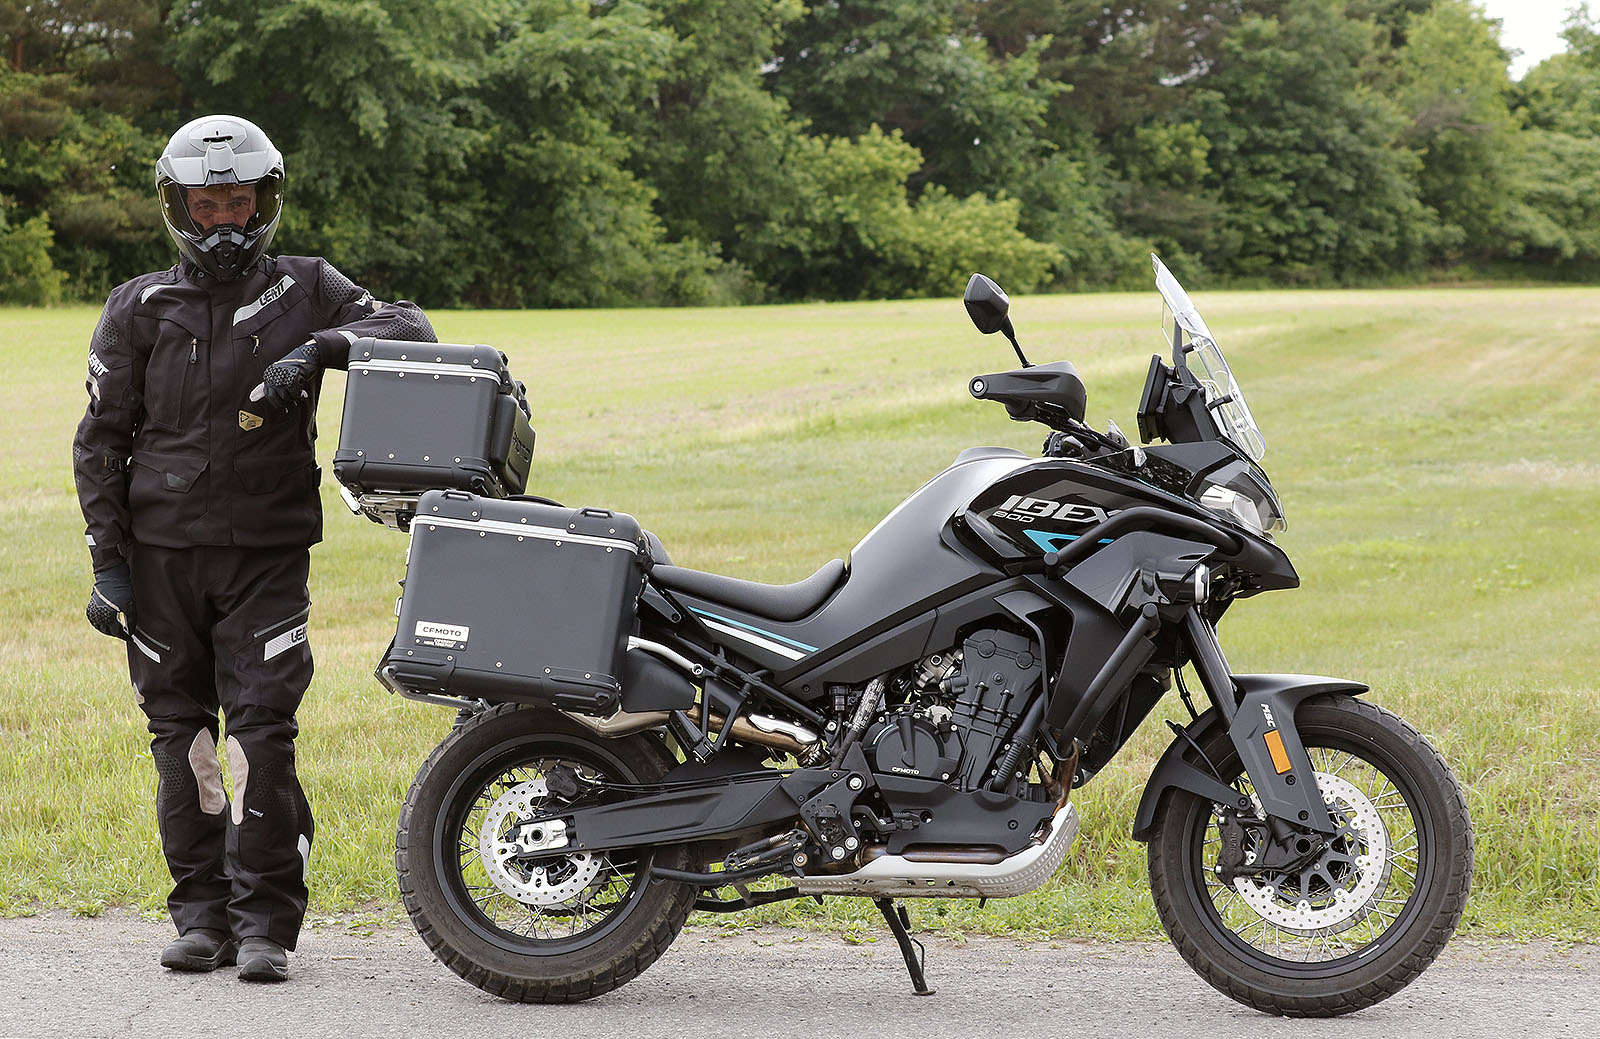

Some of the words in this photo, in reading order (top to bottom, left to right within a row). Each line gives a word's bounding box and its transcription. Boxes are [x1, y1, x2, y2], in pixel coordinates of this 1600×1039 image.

[259, 279, 285, 306] LEATT
[993, 510, 1035, 523] 800
[999, 494, 1124, 524] IBEX
[423, 627, 461, 636] CFMOTO
